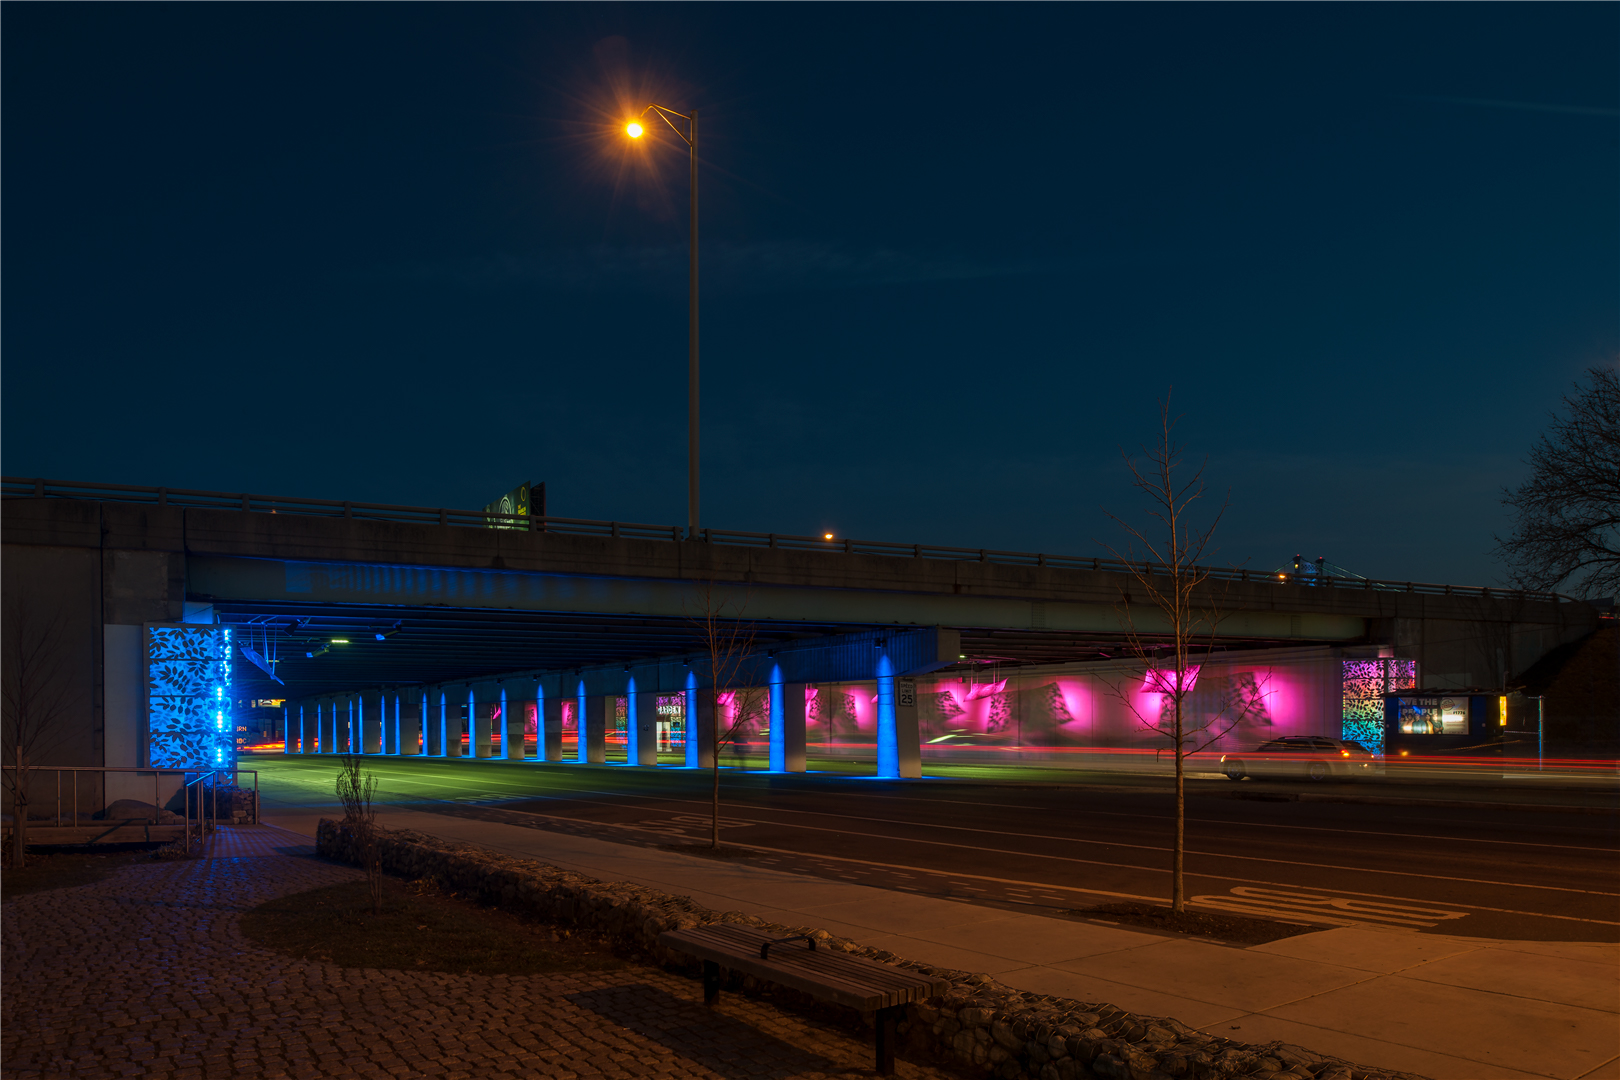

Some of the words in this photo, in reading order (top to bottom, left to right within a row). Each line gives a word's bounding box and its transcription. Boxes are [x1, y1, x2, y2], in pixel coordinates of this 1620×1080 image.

[902, 694, 912, 703] 25
[1419, 698, 1437, 706] THE
[1402, 708, 1438, 716] PEOPLE
